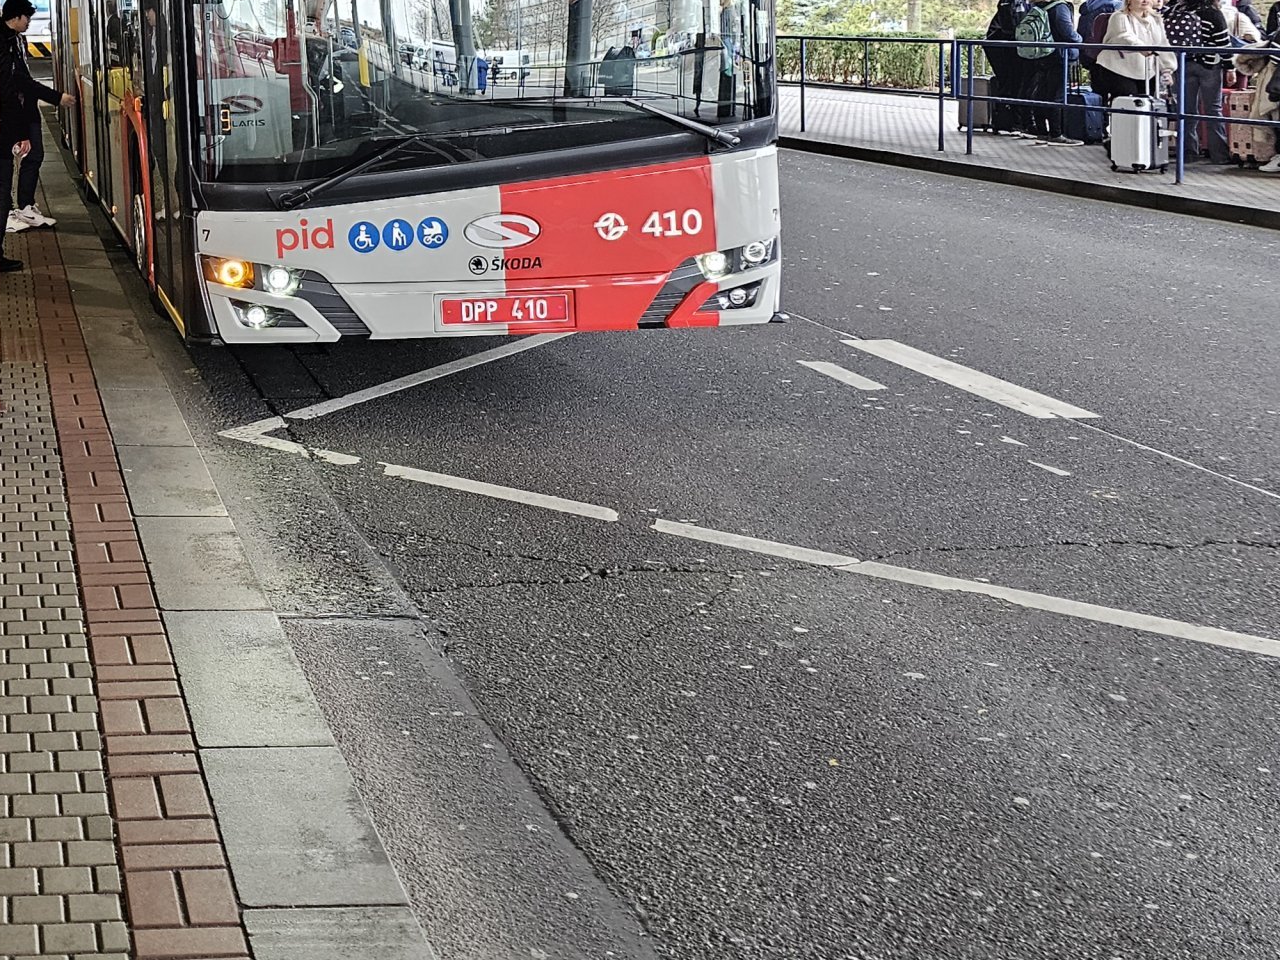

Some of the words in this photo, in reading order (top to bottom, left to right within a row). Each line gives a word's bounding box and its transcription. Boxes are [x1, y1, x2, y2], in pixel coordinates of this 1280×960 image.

[232, 119, 266, 128] LARIS
[641, 208, 703, 237] 410
[202, 229, 211, 242] 7
[275, 218, 335, 259] pid
[491, 256, 543, 271] ŠKODA
[461, 300, 498, 322] DPP
[511, 299, 548, 320] 410
